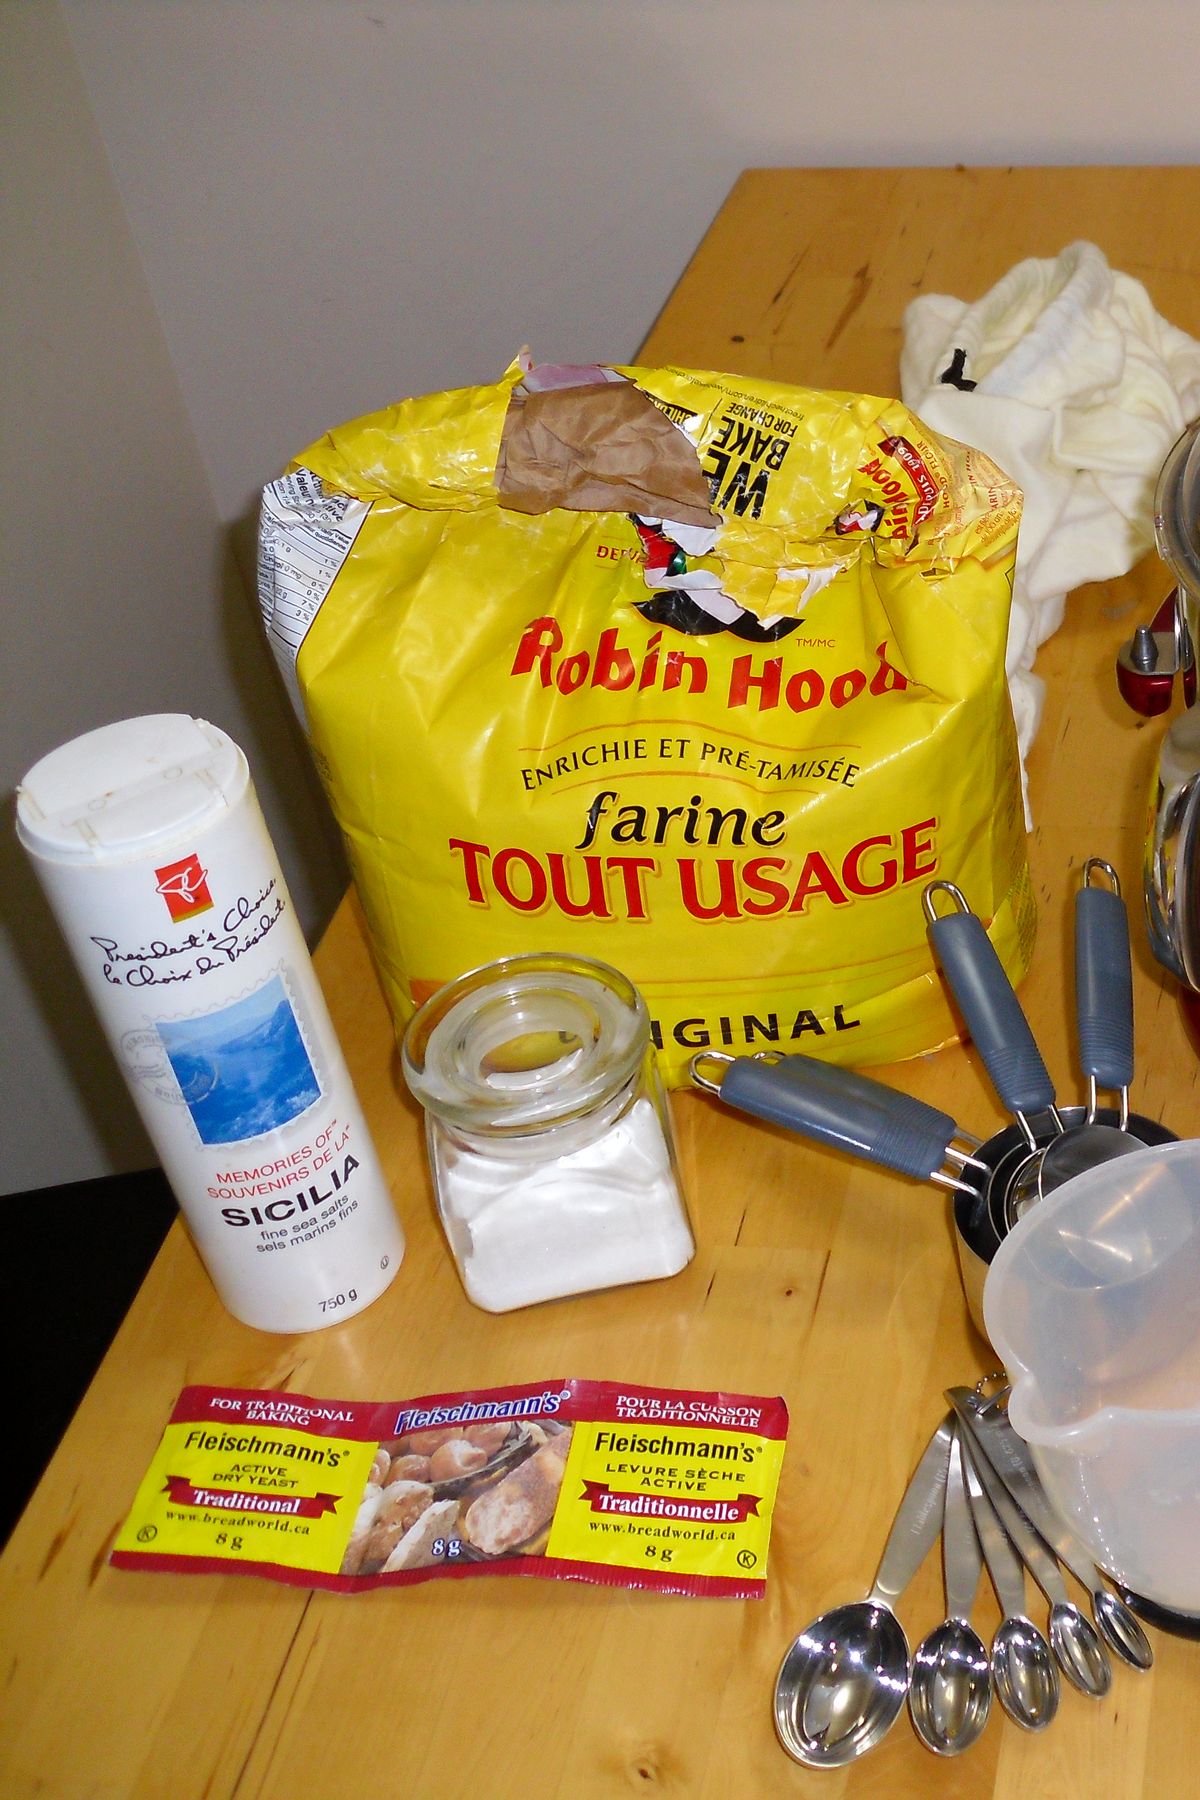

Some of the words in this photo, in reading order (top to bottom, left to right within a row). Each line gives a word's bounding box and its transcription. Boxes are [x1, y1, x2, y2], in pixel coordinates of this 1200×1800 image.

[725, 402, 775, 431] CHANGE
[774, 420, 799, 438] FOR
[711, 416, 790, 471] BAKE
[702, 447, 770, 520] WE
[795, 638, 837, 650] TM/MC
[510, 615, 706, 694] Robin
[726, 640, 910, 714] Hood
[520, 738, 648, 791] ENRICHIE
[659, 738, 690, 760] ET
[700, 741, 863, 791] PRÉ-TAMISÉE
[574, 791, 786, 850] farine
[448, 837, 655, 920] TOUT
[676, 816, 939, 921] USAGE
[90, 928, 217, 964] President's
[223, 878, 276, 932] Choice
[126, 964, 192, 986] Choix
[212, 897, 285, 963] Président
[650, 1004, 861, 1050] IGINAL
[207, 1166, 310, 1199] SOUVENIRS
[313, 1149, 333, 1172] DE
[334, 1131, 350, 1152] LA
[216, 1145, 312, 1185] MEMORIES
[221, 1154, 360, 1227] SICILIA
[256, 1239, 286, 1253] sels
[289, 1219, 337, 1247] marins
[338, 1200, 359, 1221] fins
[260, 1228, 289, 1241] fine
[292, 1216, 318, 1233] sea
[320, 1195, 349, 1220] salts
[318, 1294, 346, 1313] 750
[348, 1288, 358, 1302] g
[209, 1397, 242, 1411] FOR
[245, 1400, 355, 1422] TRADITIONAL
[246, 1410, 311, 1426] BAKING
[393, 1391, 561, 1435] Fleischmann's
[616, 1395, 661, 1410] POUR
[664, 1398, 685, 1411] LA
[689, 1401, 762, 1418] CUISSON
[616, 1406, 760, 1428] TRADITIONNELLE
[184, 1431, 342, 1467] Fleischmann's
[594, 1432, 755, 1463] Fleischmann's
[212, 1473, 244, 1483] DRY
[248, 1476, 299, 1489] YEAST
[230, 1464, 288, 1477] ACTIVE
[606, 1463, 678, 1478] LEVURE
[685, 1466, 746, 1483] SÈCHE
[640, 1477, 707, 1492] ACTIVE
[193, 1489, 301, 1514] Traditional
[599, 1493, 739, 1522] Traditionnelle
[166, 1510, 311, 1536] www.breadworld.ca
[589, 1520, 736, 1541] www.breadworld.ca
[216, 1533, 227, 1545] 8
[231, 1536, 244, 1551] g
[432, 1538, 445, 1556] 8
[448, 1538, 462, 1557] g
[644, 1545, 656, 1558] 8
[661, 1547, 674, 1563] g
